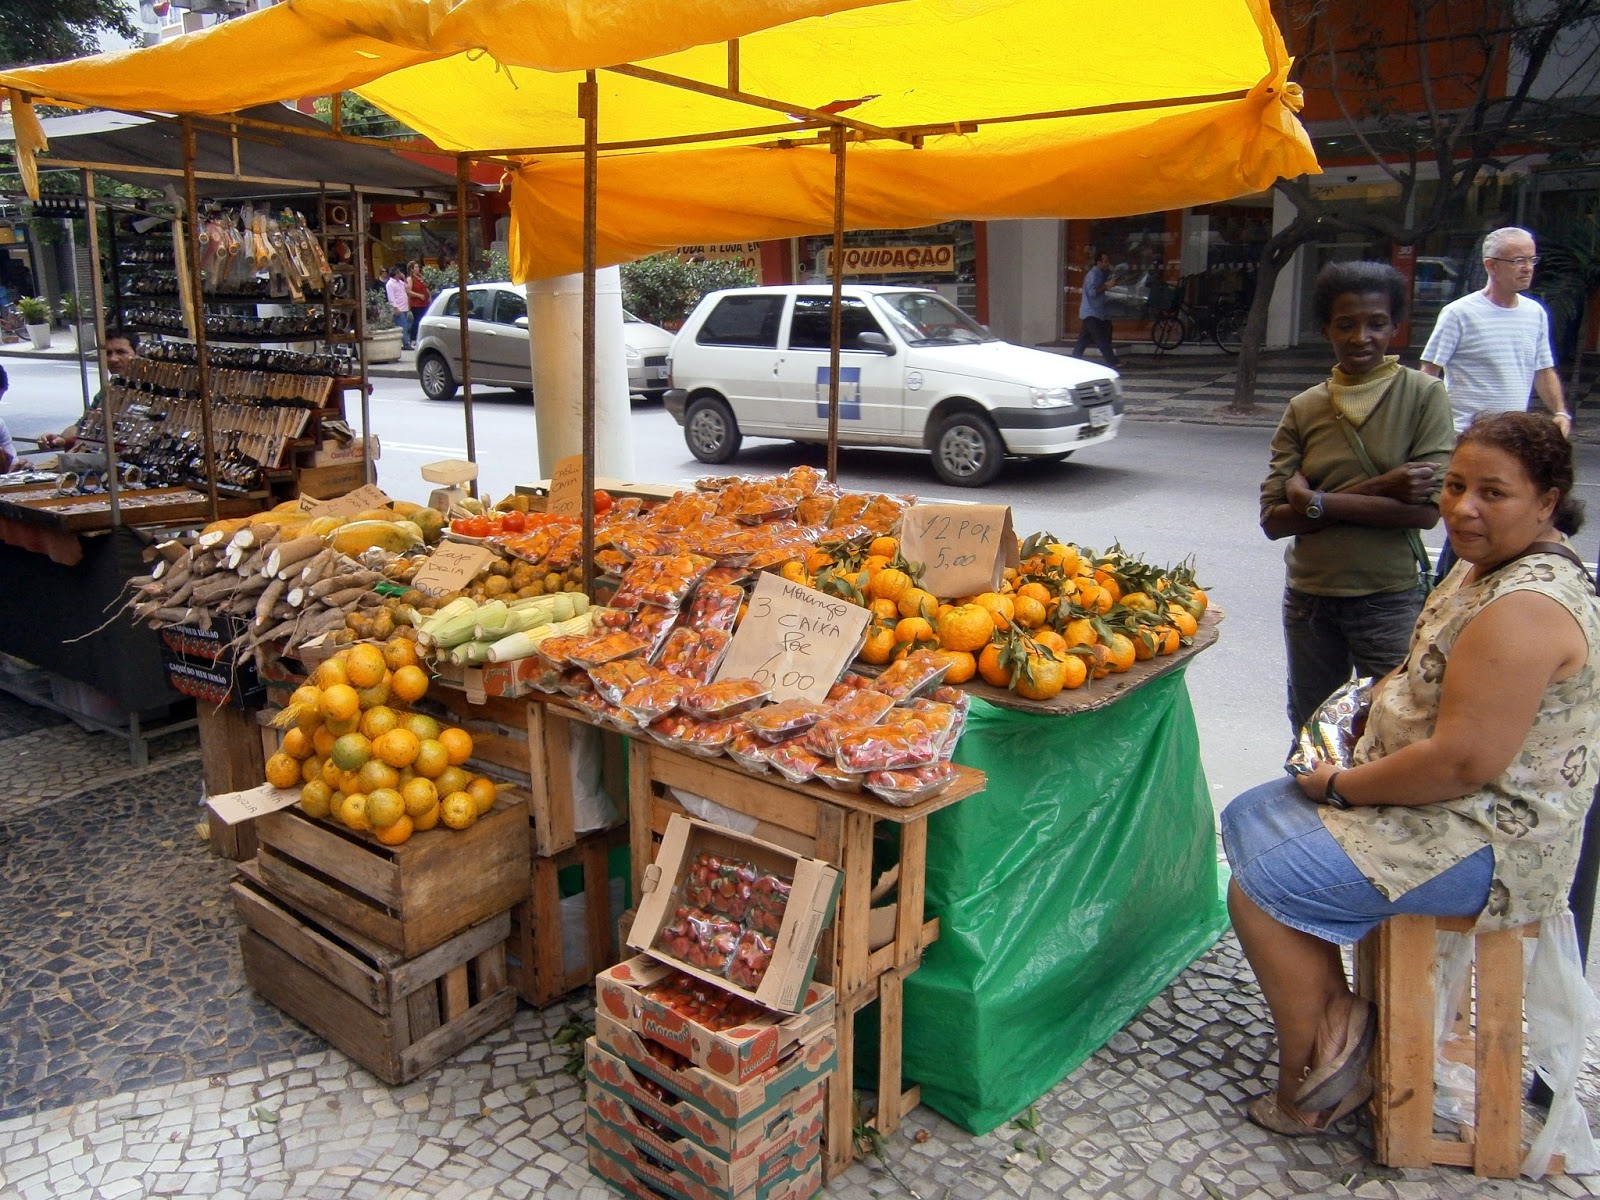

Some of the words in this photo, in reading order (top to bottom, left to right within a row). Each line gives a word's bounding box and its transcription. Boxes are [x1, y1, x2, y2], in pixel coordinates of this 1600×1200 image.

[919, 515, 951, 540] 12
[958, 520, 991, 544] POR
[933, 547, 976, 570] 5,00
[754, 597, 772, 618] 3
[751, 652, 815, 690] 6,00
[645, 1018, 691, 1045] Morangos
